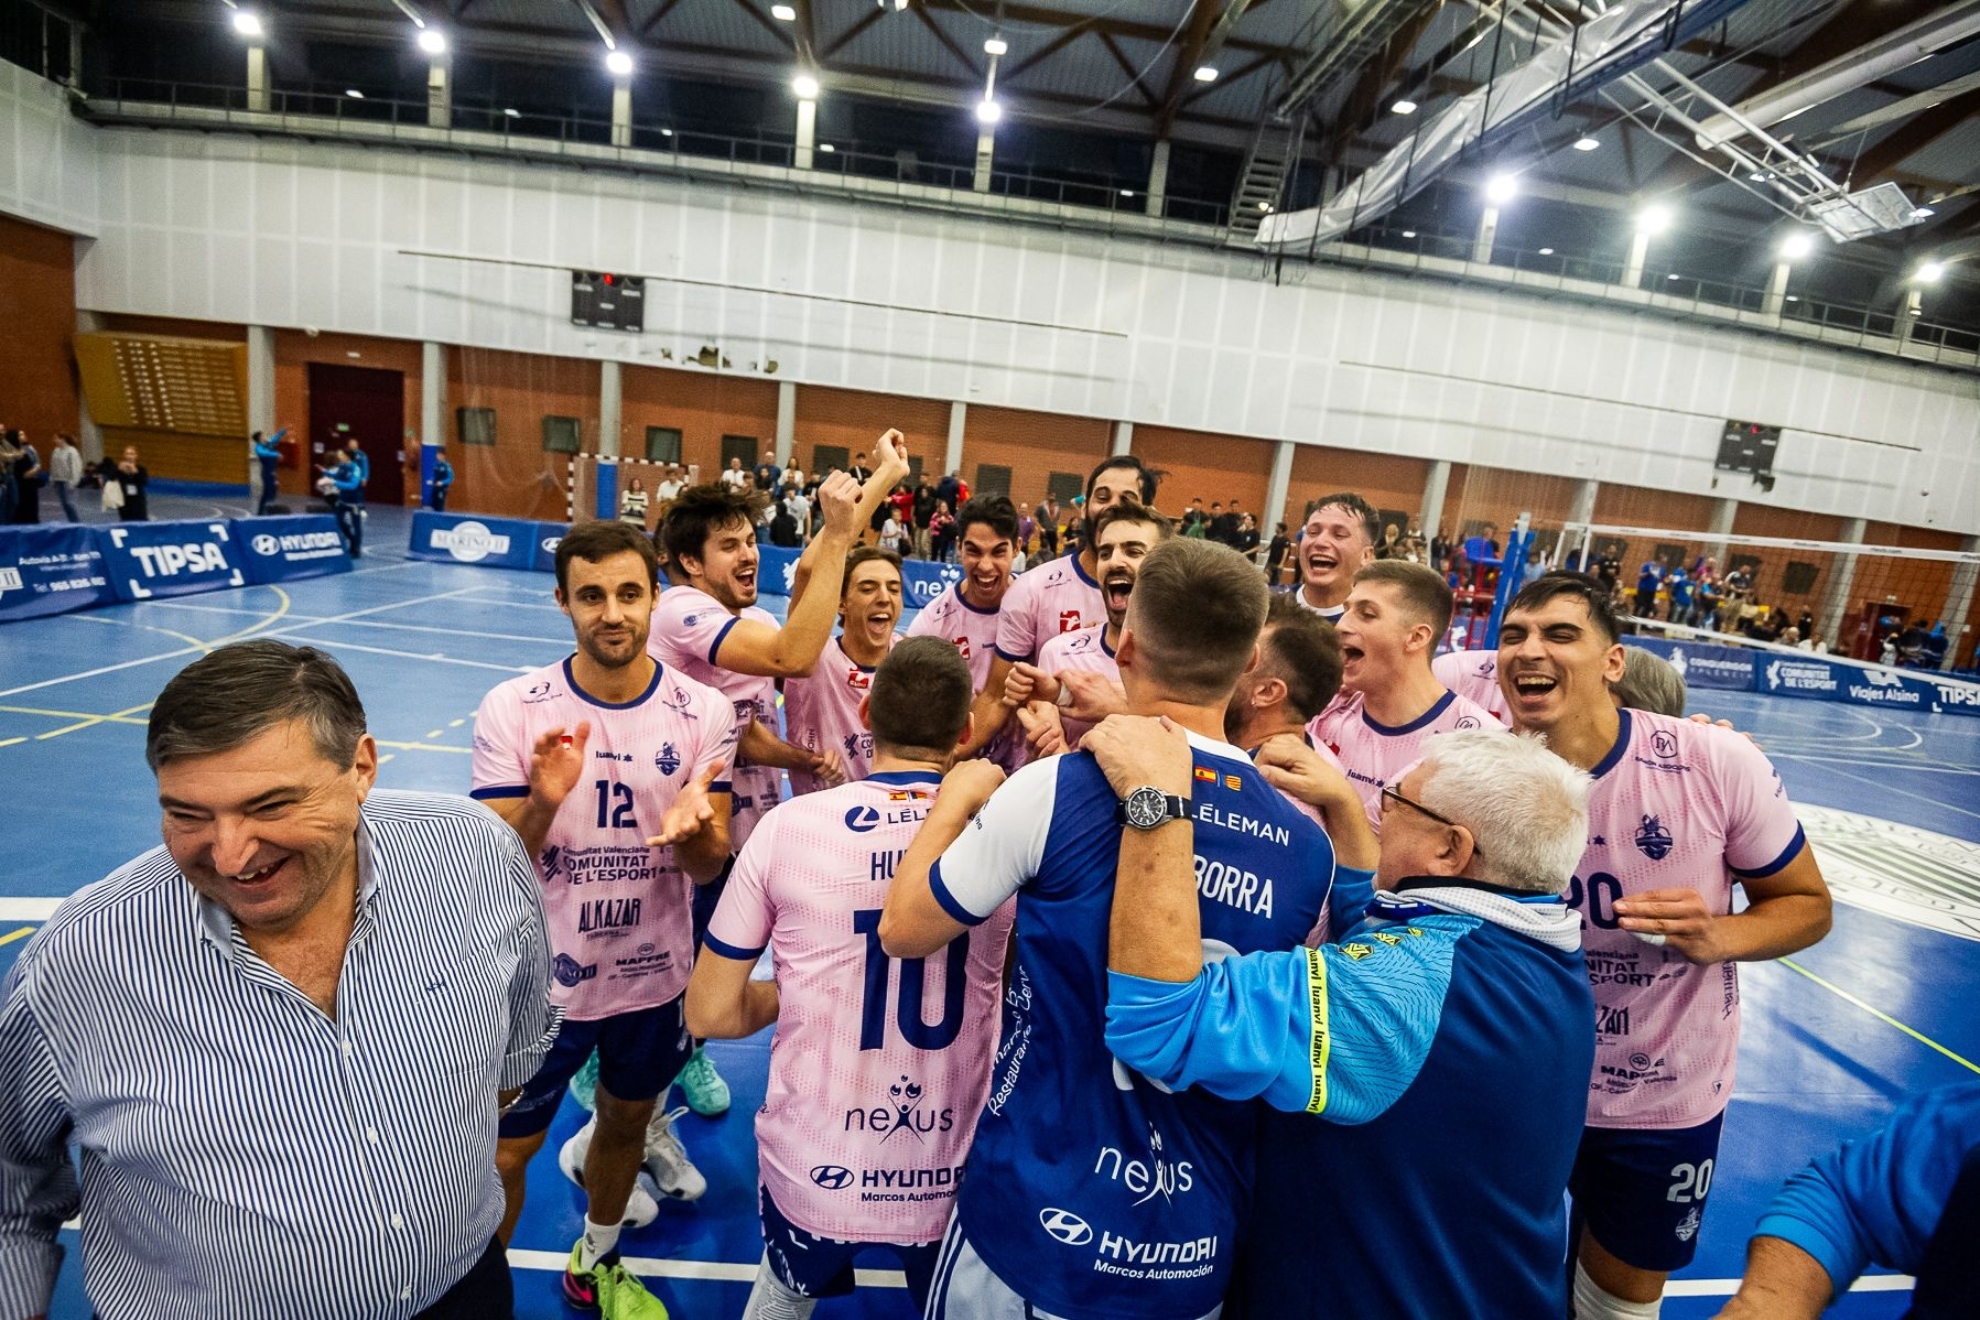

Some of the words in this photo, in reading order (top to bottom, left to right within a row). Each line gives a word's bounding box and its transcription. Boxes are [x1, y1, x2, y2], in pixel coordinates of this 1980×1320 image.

[279, 532, 341, 551] HYUNDAI
[130, 542, 228, 578] TIPSA
[1849, 685, 1883, 702] Viajes
[1937, 686, 1980, 706] TIPS
[595, 779, 638, 829] 12
[887, 808, 932, 824] LÉL
[1192, 803, 1290, 847] ÉLEMAN
[563, 854, 650, 872] COMUNITAT
[871, 849, 908, 881] HU
[578, 897, 642, 934] ALKAZAR
[1584, 949, 1640, 960] alenciana
[1585, 959, 1640, 975] NITAT
[853, 909, 970, 1051] 10
[1588, 972, 1656, 987] SPORT
[1311, 985, 1323, 1025] luanvi
[1312, 1030, 1326, 1069] luanvi
[1666, 1158, 1714, 1203] 20
[860, 1191, 906, 1203] Marcos
[907, 1190, 958, 1203] Automo
[1099, 1231, 1218, 1264] HYUNDAI
[1094, 1259, 1144, 1280] Marcos
[1145, 1262, 1214, 1280] Automoción
